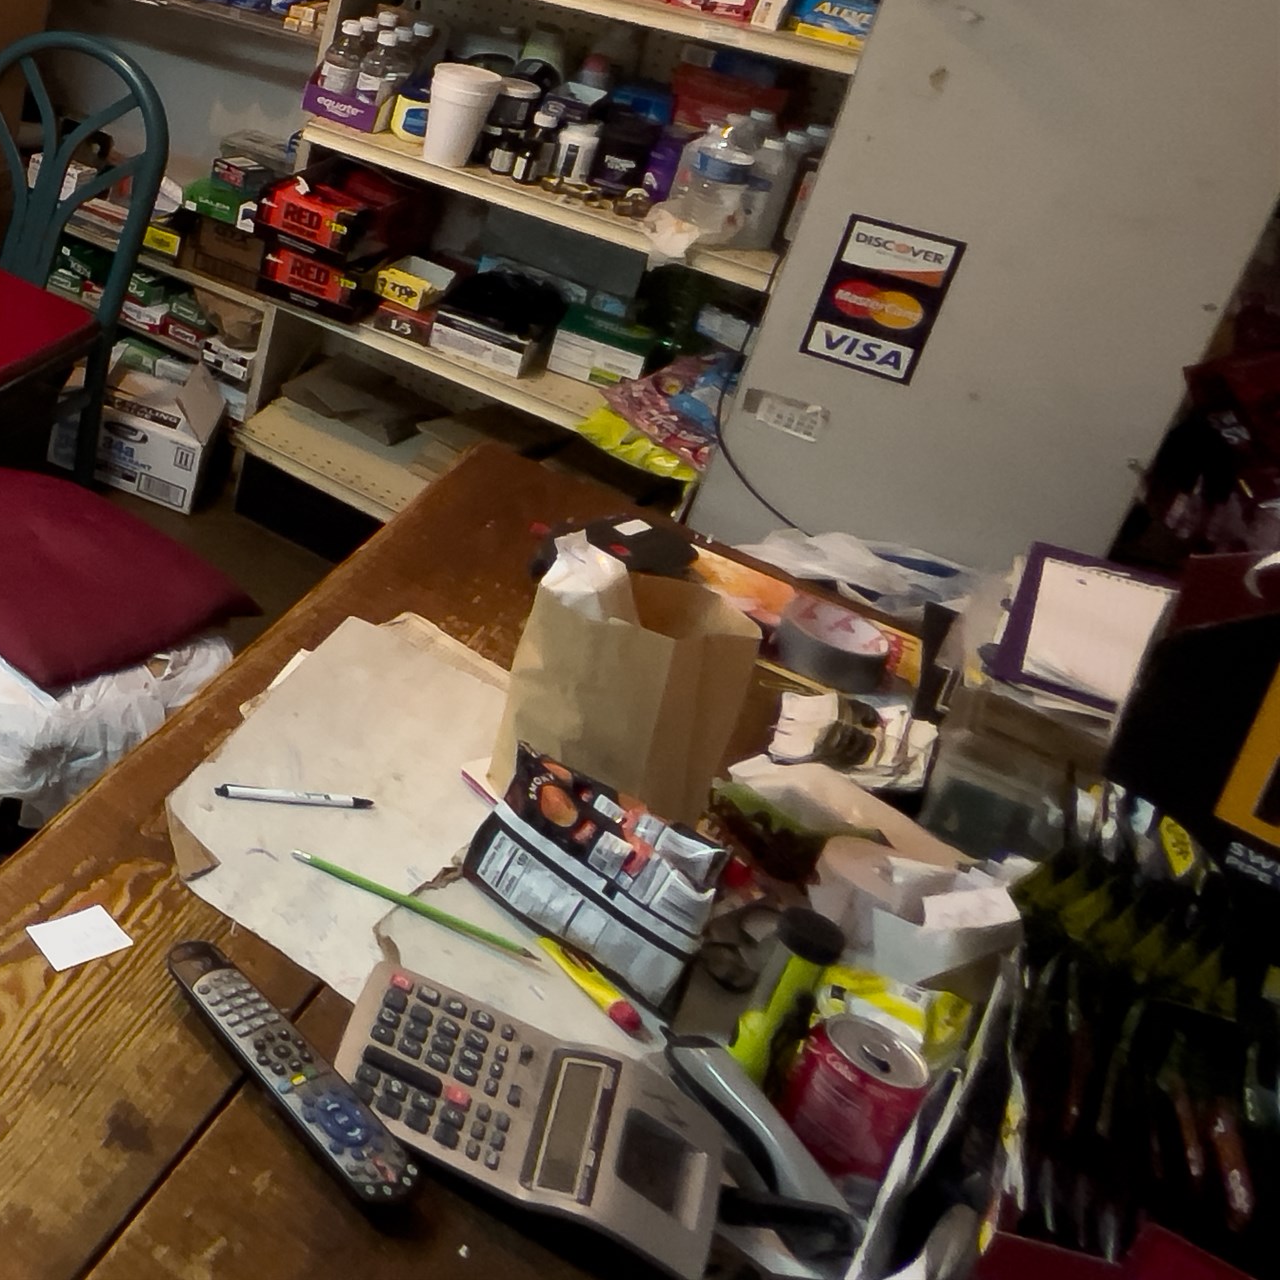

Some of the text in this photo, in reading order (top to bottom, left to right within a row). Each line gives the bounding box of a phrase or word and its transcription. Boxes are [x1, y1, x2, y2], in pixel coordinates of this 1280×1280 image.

[316, 94, 364, 118] equate
[283, 202, 323, 230] RED
[854, 232, 946, 265] DISCOVER
[290, 259, 330, 285] RED
[834, 288, 923, 321] MasterCard
[822, 329, 903, 371] VISA
